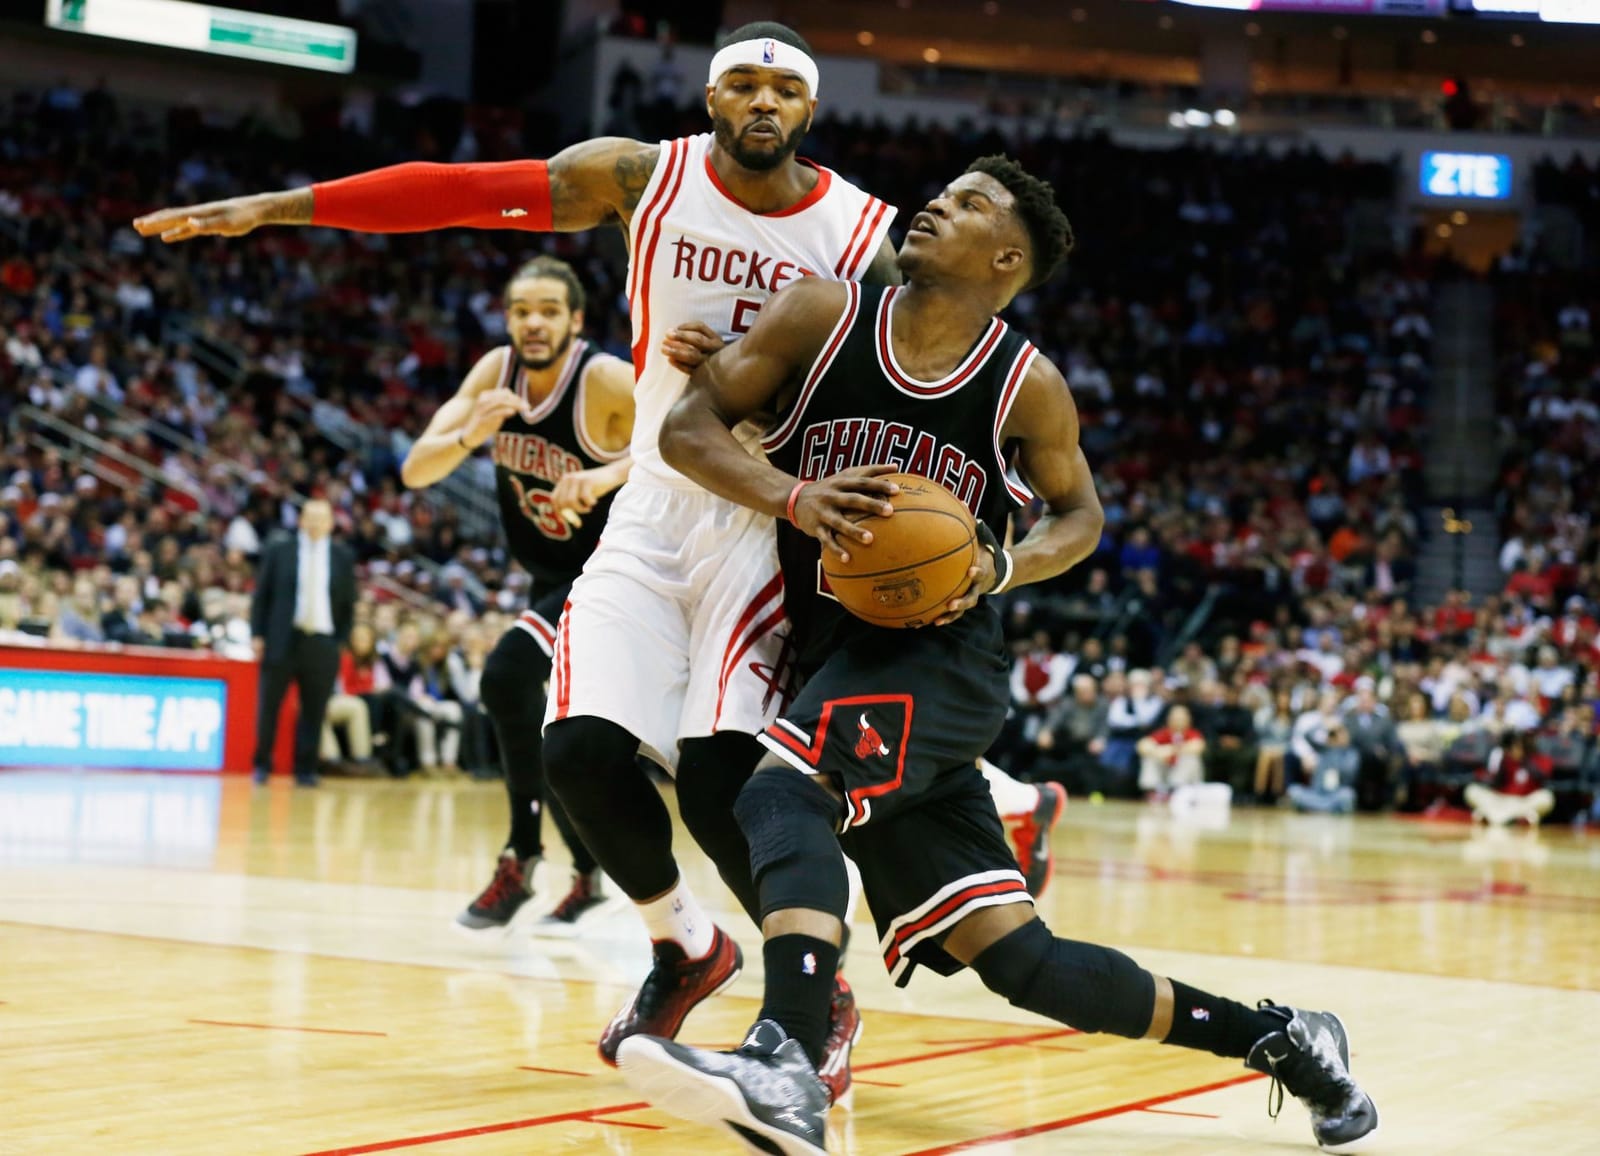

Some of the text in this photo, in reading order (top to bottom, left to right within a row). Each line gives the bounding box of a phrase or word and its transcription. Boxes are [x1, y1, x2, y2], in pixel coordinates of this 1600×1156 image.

[1429, 153, 1500, 197] ZTE
[801, 417, 987, 519] CHICAGO
[83, 692, 156, 750] TIME
[155, 695, 222, 752] APP
